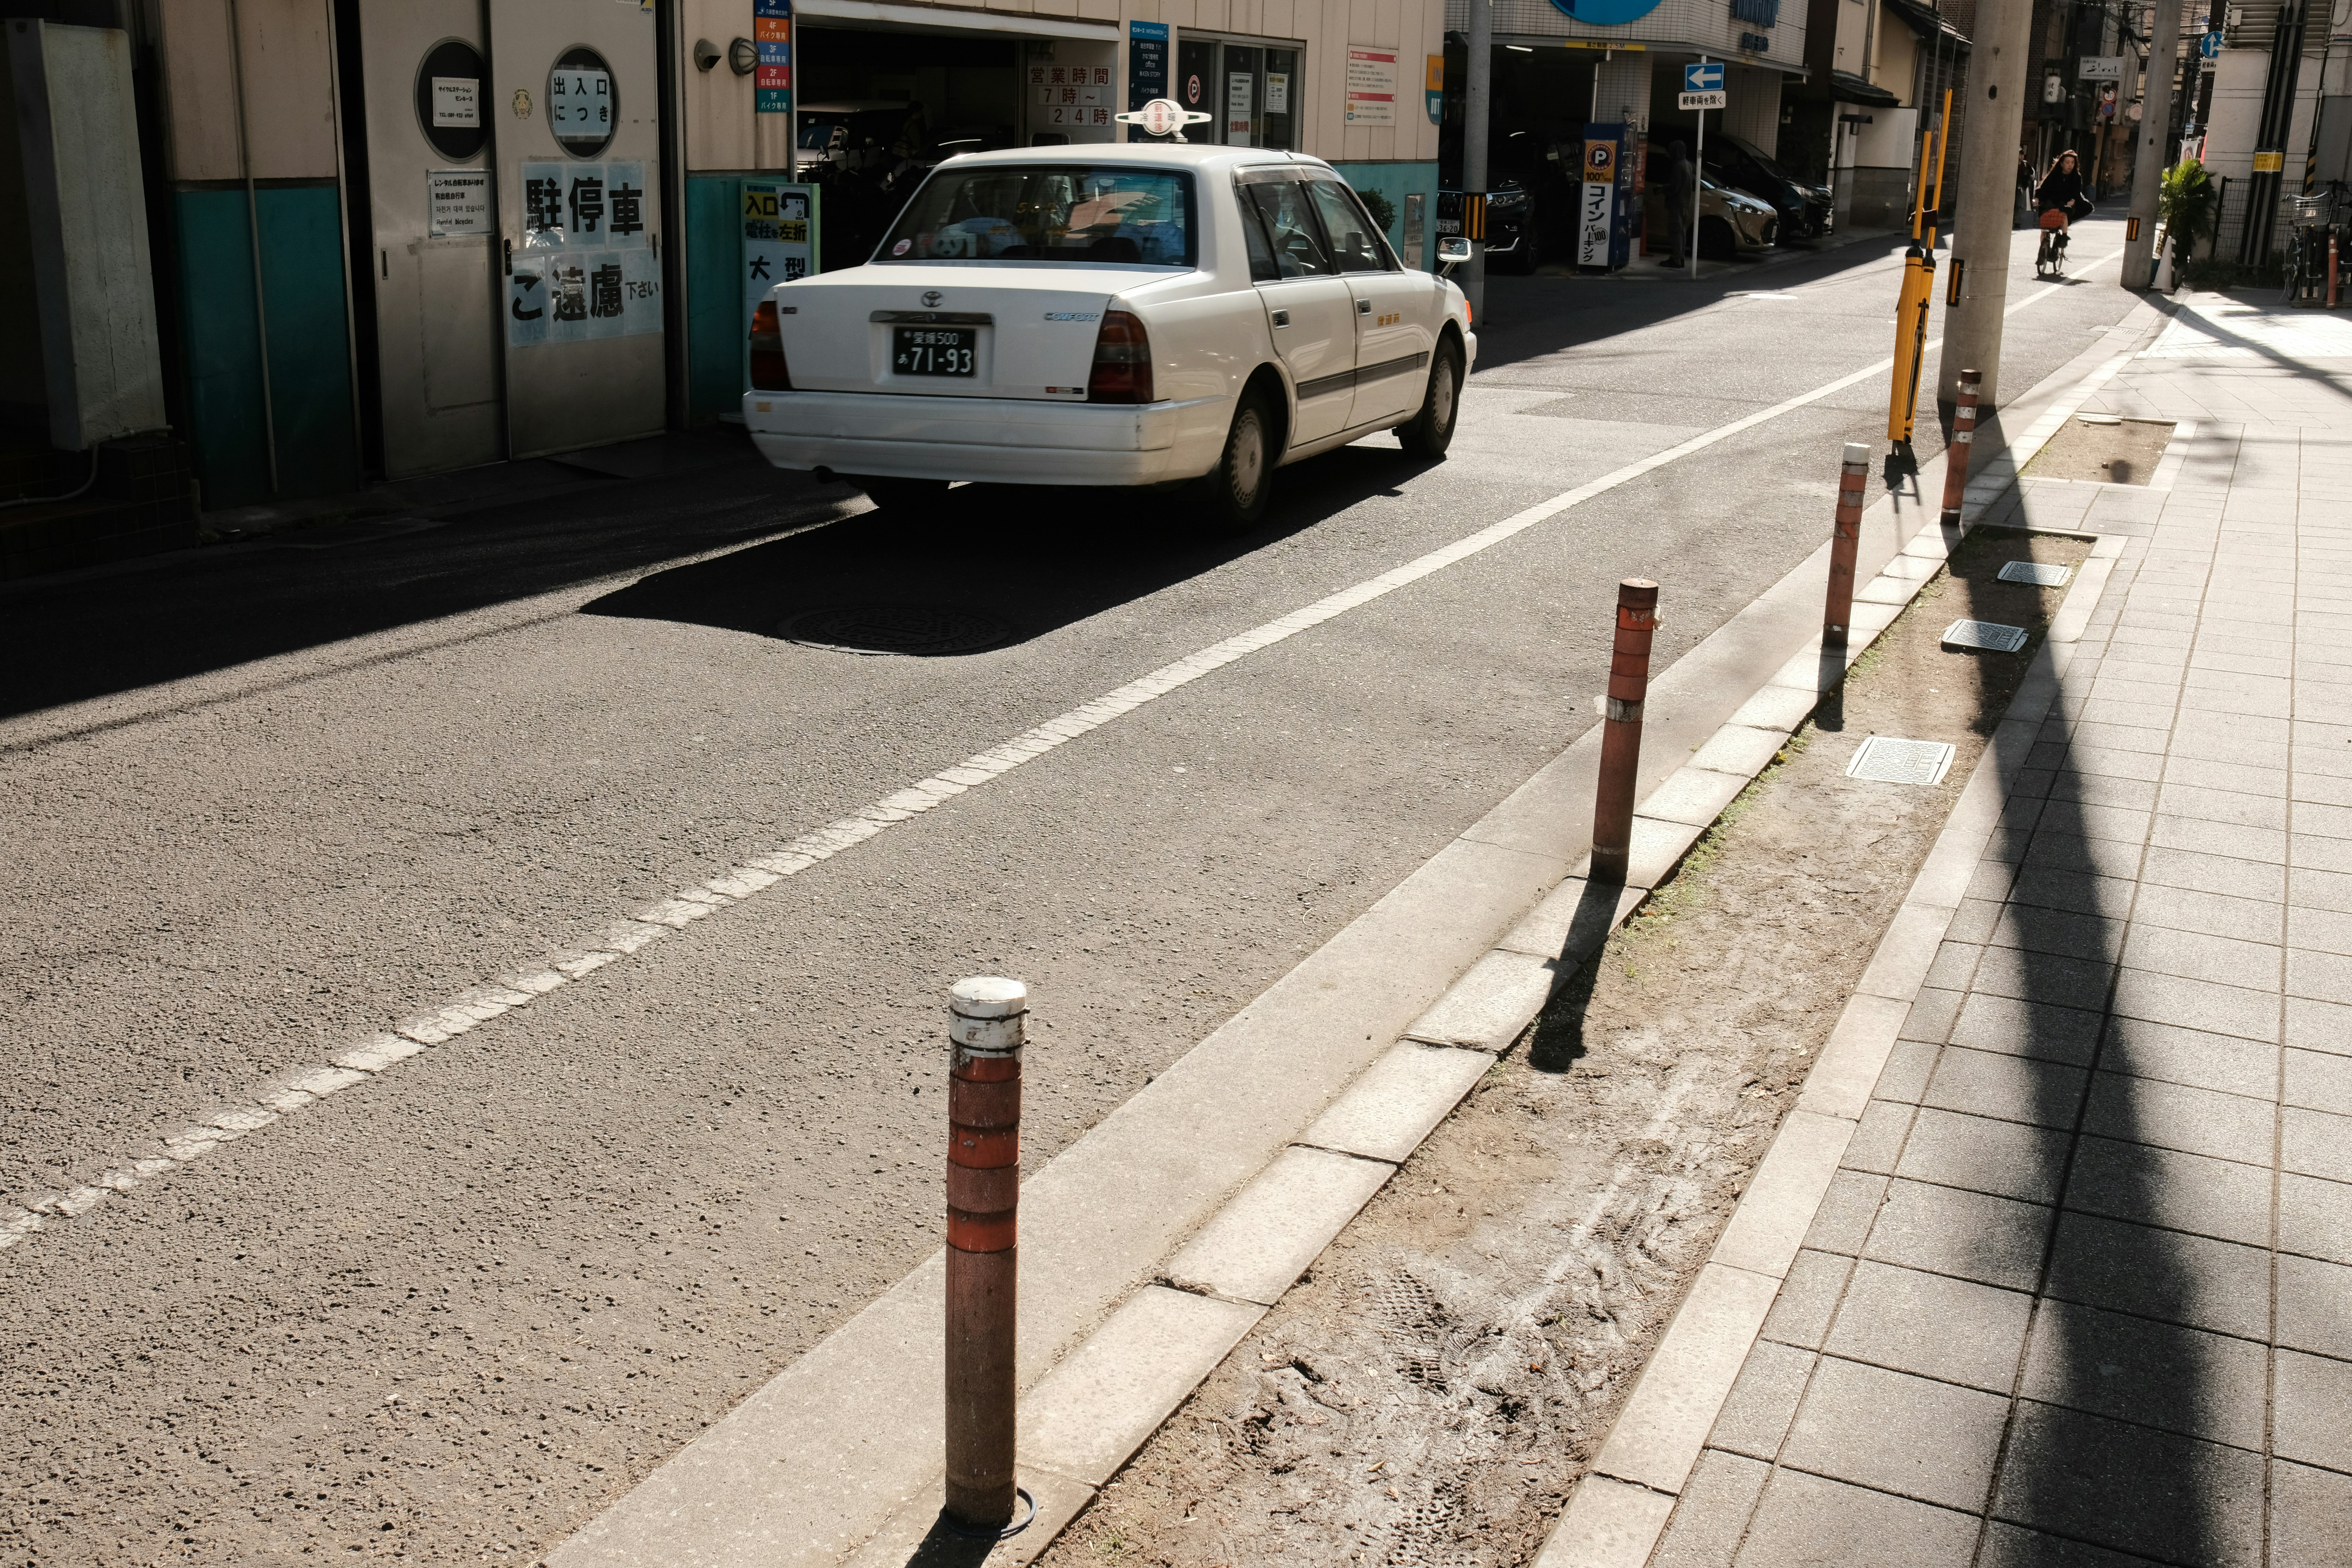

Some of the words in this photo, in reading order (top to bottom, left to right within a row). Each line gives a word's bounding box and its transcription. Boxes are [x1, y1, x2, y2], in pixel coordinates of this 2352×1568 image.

[769, 21, 776, 29] 4F
[760, 31, 786, 40] バイク専用
[760, 55, 786, 64] 自転車専用
[770, 68, 777, 76] 2F
[1030, 67, 1109, 85] 営業時間
[1433, 66, 1441, 82] IN
[554, 76, 607, 96] 出入口
[761, 78, 786, 87] 自転車専用
[1192, 83, 1197, 94] P
[1431, 98, 1440, 115] OUT
[1682, 94, 1722, 106] 軽車両を除く
[554, 105, 608, 122] につき
[1055, 108, 1108, 124] 24時
[1595, 150, 1607, 164] P
[526, 177, 643, 236] 駐停車
[745, 195, 778, 216] 入口
[745, 222, 807, 241] 電柱を左折
[1439, 224, 1457, 232] 36-20
[1594, 230, 1606, 241] 100
[749, 255, 806, 282] 大型
[1044, 312, 1099, 321] COMFORT
[897, 352, 909, 365] あ
[911, 347, 972, 373] 71-93
